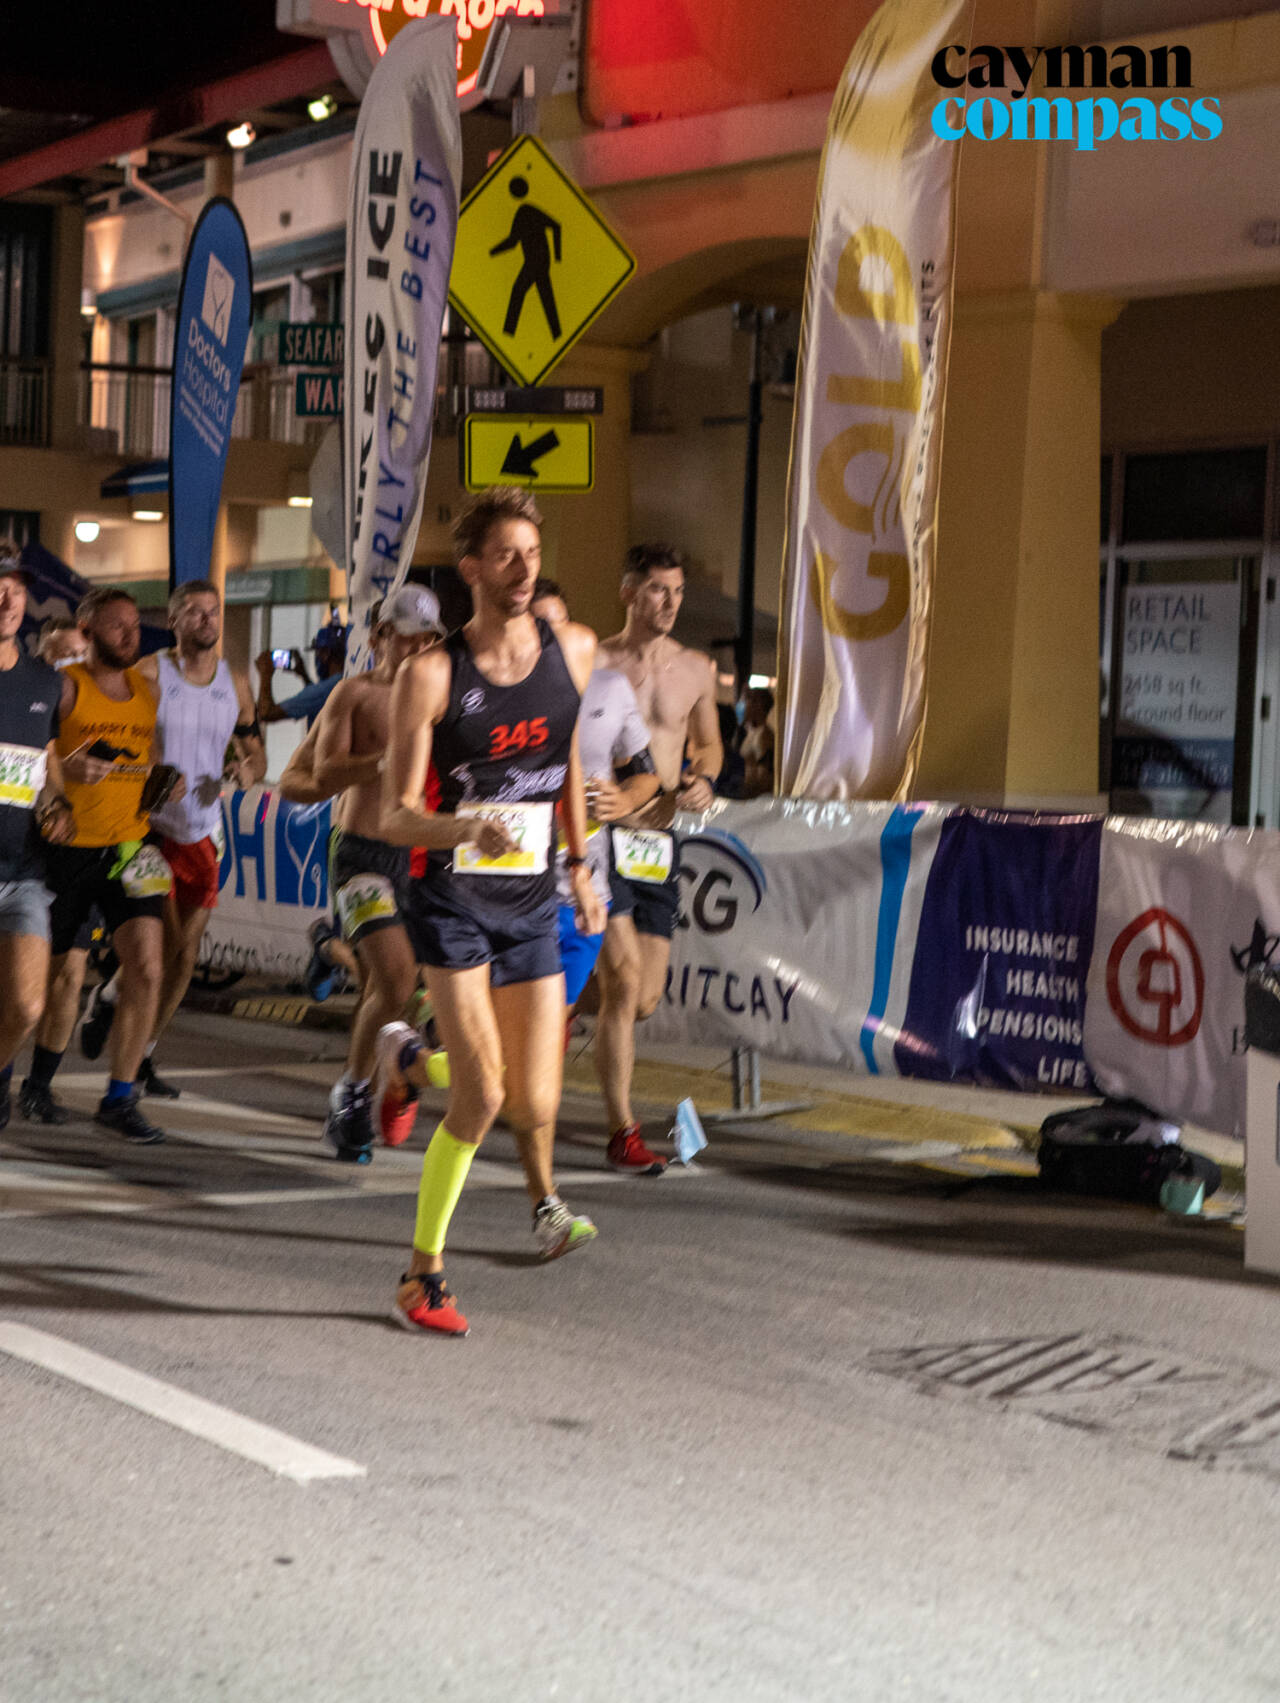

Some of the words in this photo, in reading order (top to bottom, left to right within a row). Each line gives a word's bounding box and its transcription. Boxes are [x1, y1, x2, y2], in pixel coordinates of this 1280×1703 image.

[367, 150, 402, 280] ICE
[400, 159, 443, 304] BEST
[187, 317, 232, 392] Doctors
[183, 349, 230, 425] Hospital
[387, 330, 417, 431] THE
[1127, 594, 1210, 622] RETAIL
[1125, 627, 1202, 655] SPACE
[1188, 702, 1226, 722] floor
[489, 716, 550, 755] 345
[966, 925, 1080, 964] INSURANCE
[1006, 969, 1080, 1003] HEALTH
[977, 1008, 1082, 1046] PENSIONS
[1037, 1056, 1087, 1088] LIFE
